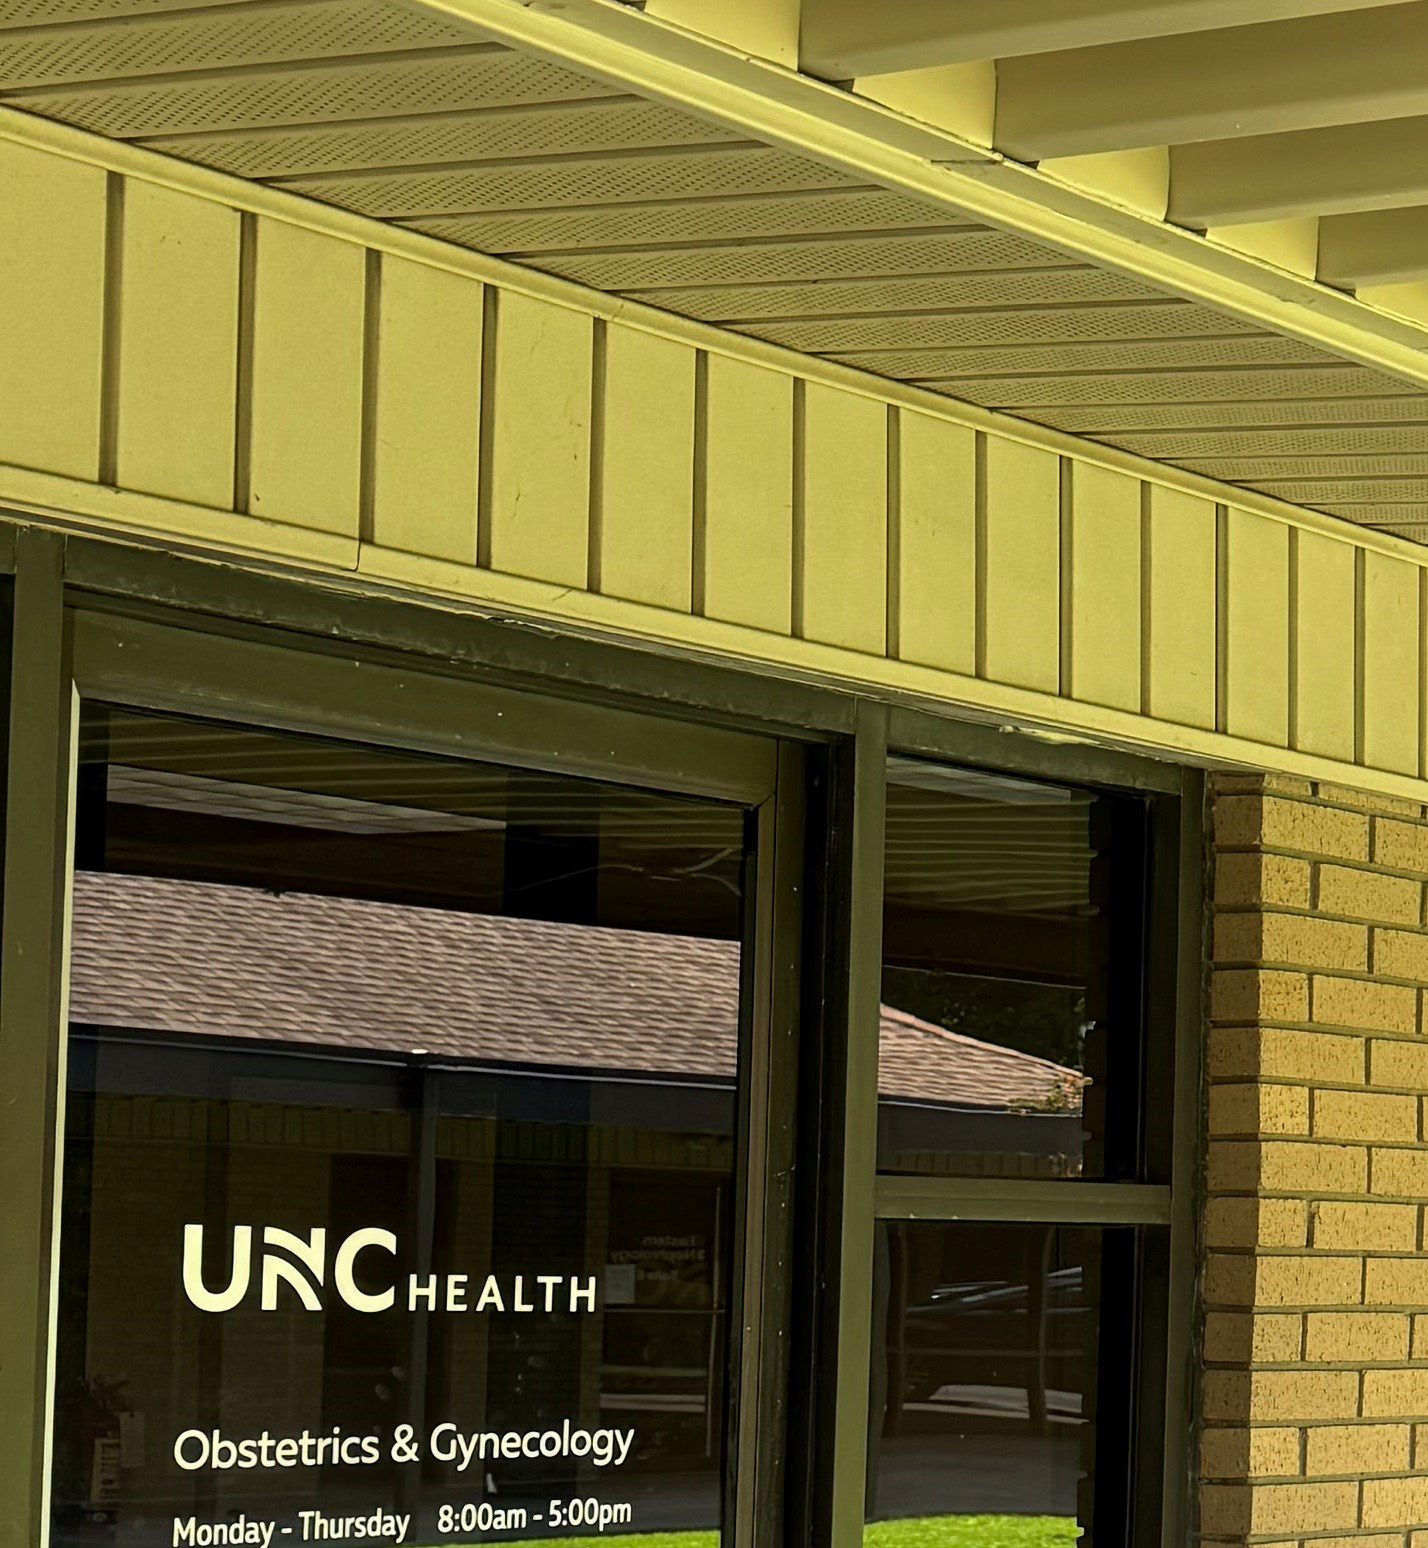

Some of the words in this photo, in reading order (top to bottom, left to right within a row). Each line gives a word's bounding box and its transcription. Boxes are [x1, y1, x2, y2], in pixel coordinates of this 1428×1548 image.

[182, 1224, 397, 1312] UNC
[407, 1273, 596, 1312] HEALTH
[173, 1424, 379, 1471] Obstetrics
[391, 1423, 419, 1463] &
[430, 1418, 635, 1472] Gynecology
[298, 1507, 411, 1544] Thursday
[437, 1502, 527, 1534] 8:00am
[548, 1497, 632, 1532] 5:00pm
